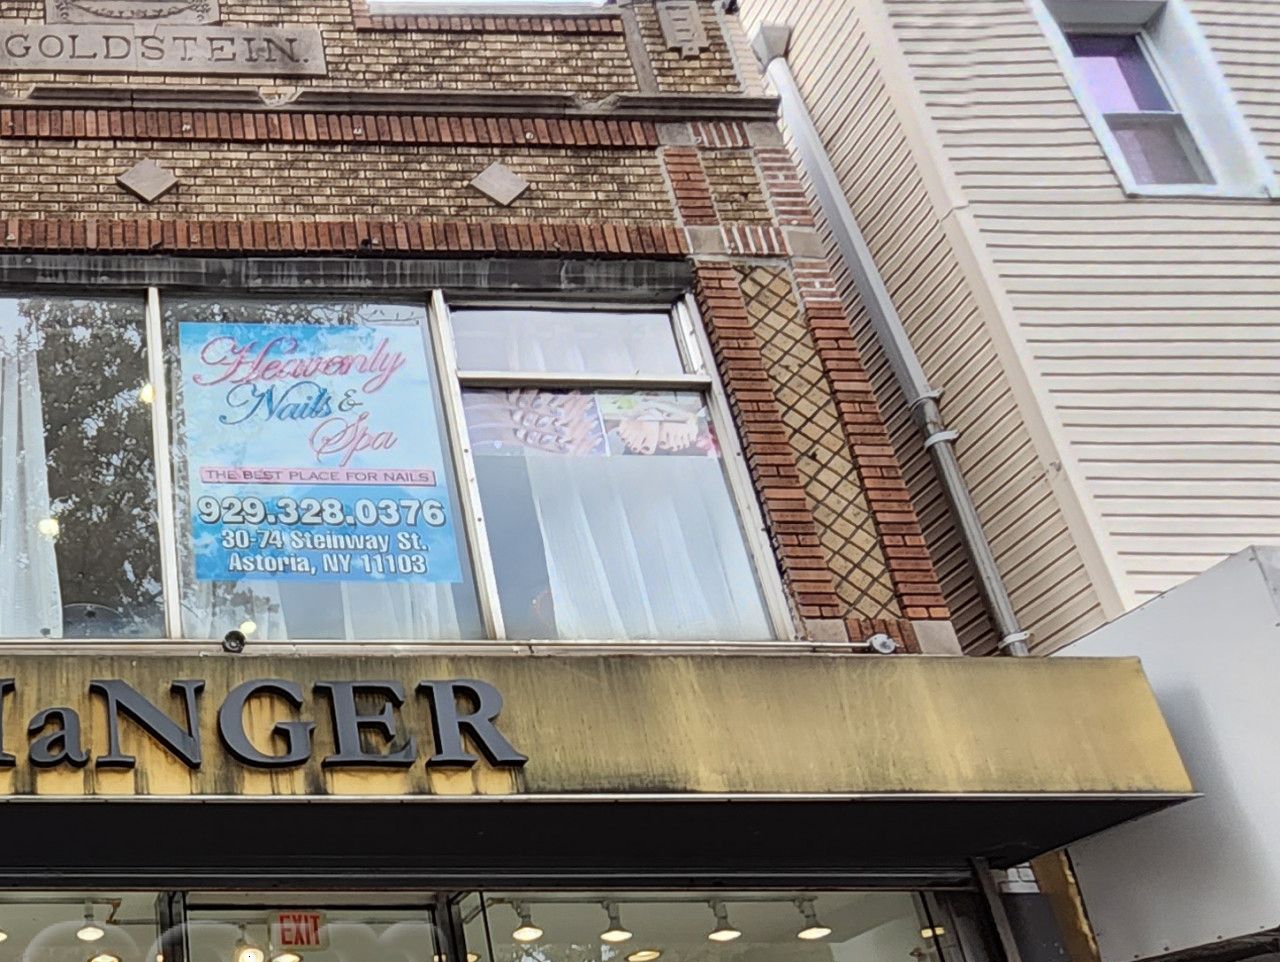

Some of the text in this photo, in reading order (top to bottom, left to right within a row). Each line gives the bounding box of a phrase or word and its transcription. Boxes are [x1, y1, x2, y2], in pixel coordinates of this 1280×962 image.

[192, 336, 407, 393] Heavenly
[219, 381, 363, 425] Nails &
[309, 411, 398, 467] Spa
[204, 470, 430, 483] THE BEST PLACE FOR NAILS
[197, 496, 447, 526] 929.328.0376
[221, 529, 430, 552] 30-74 Steinway St.
[227, 552, 428, 576] Astoria, NY 11103
[278, 913, 321, 946] EXIT
